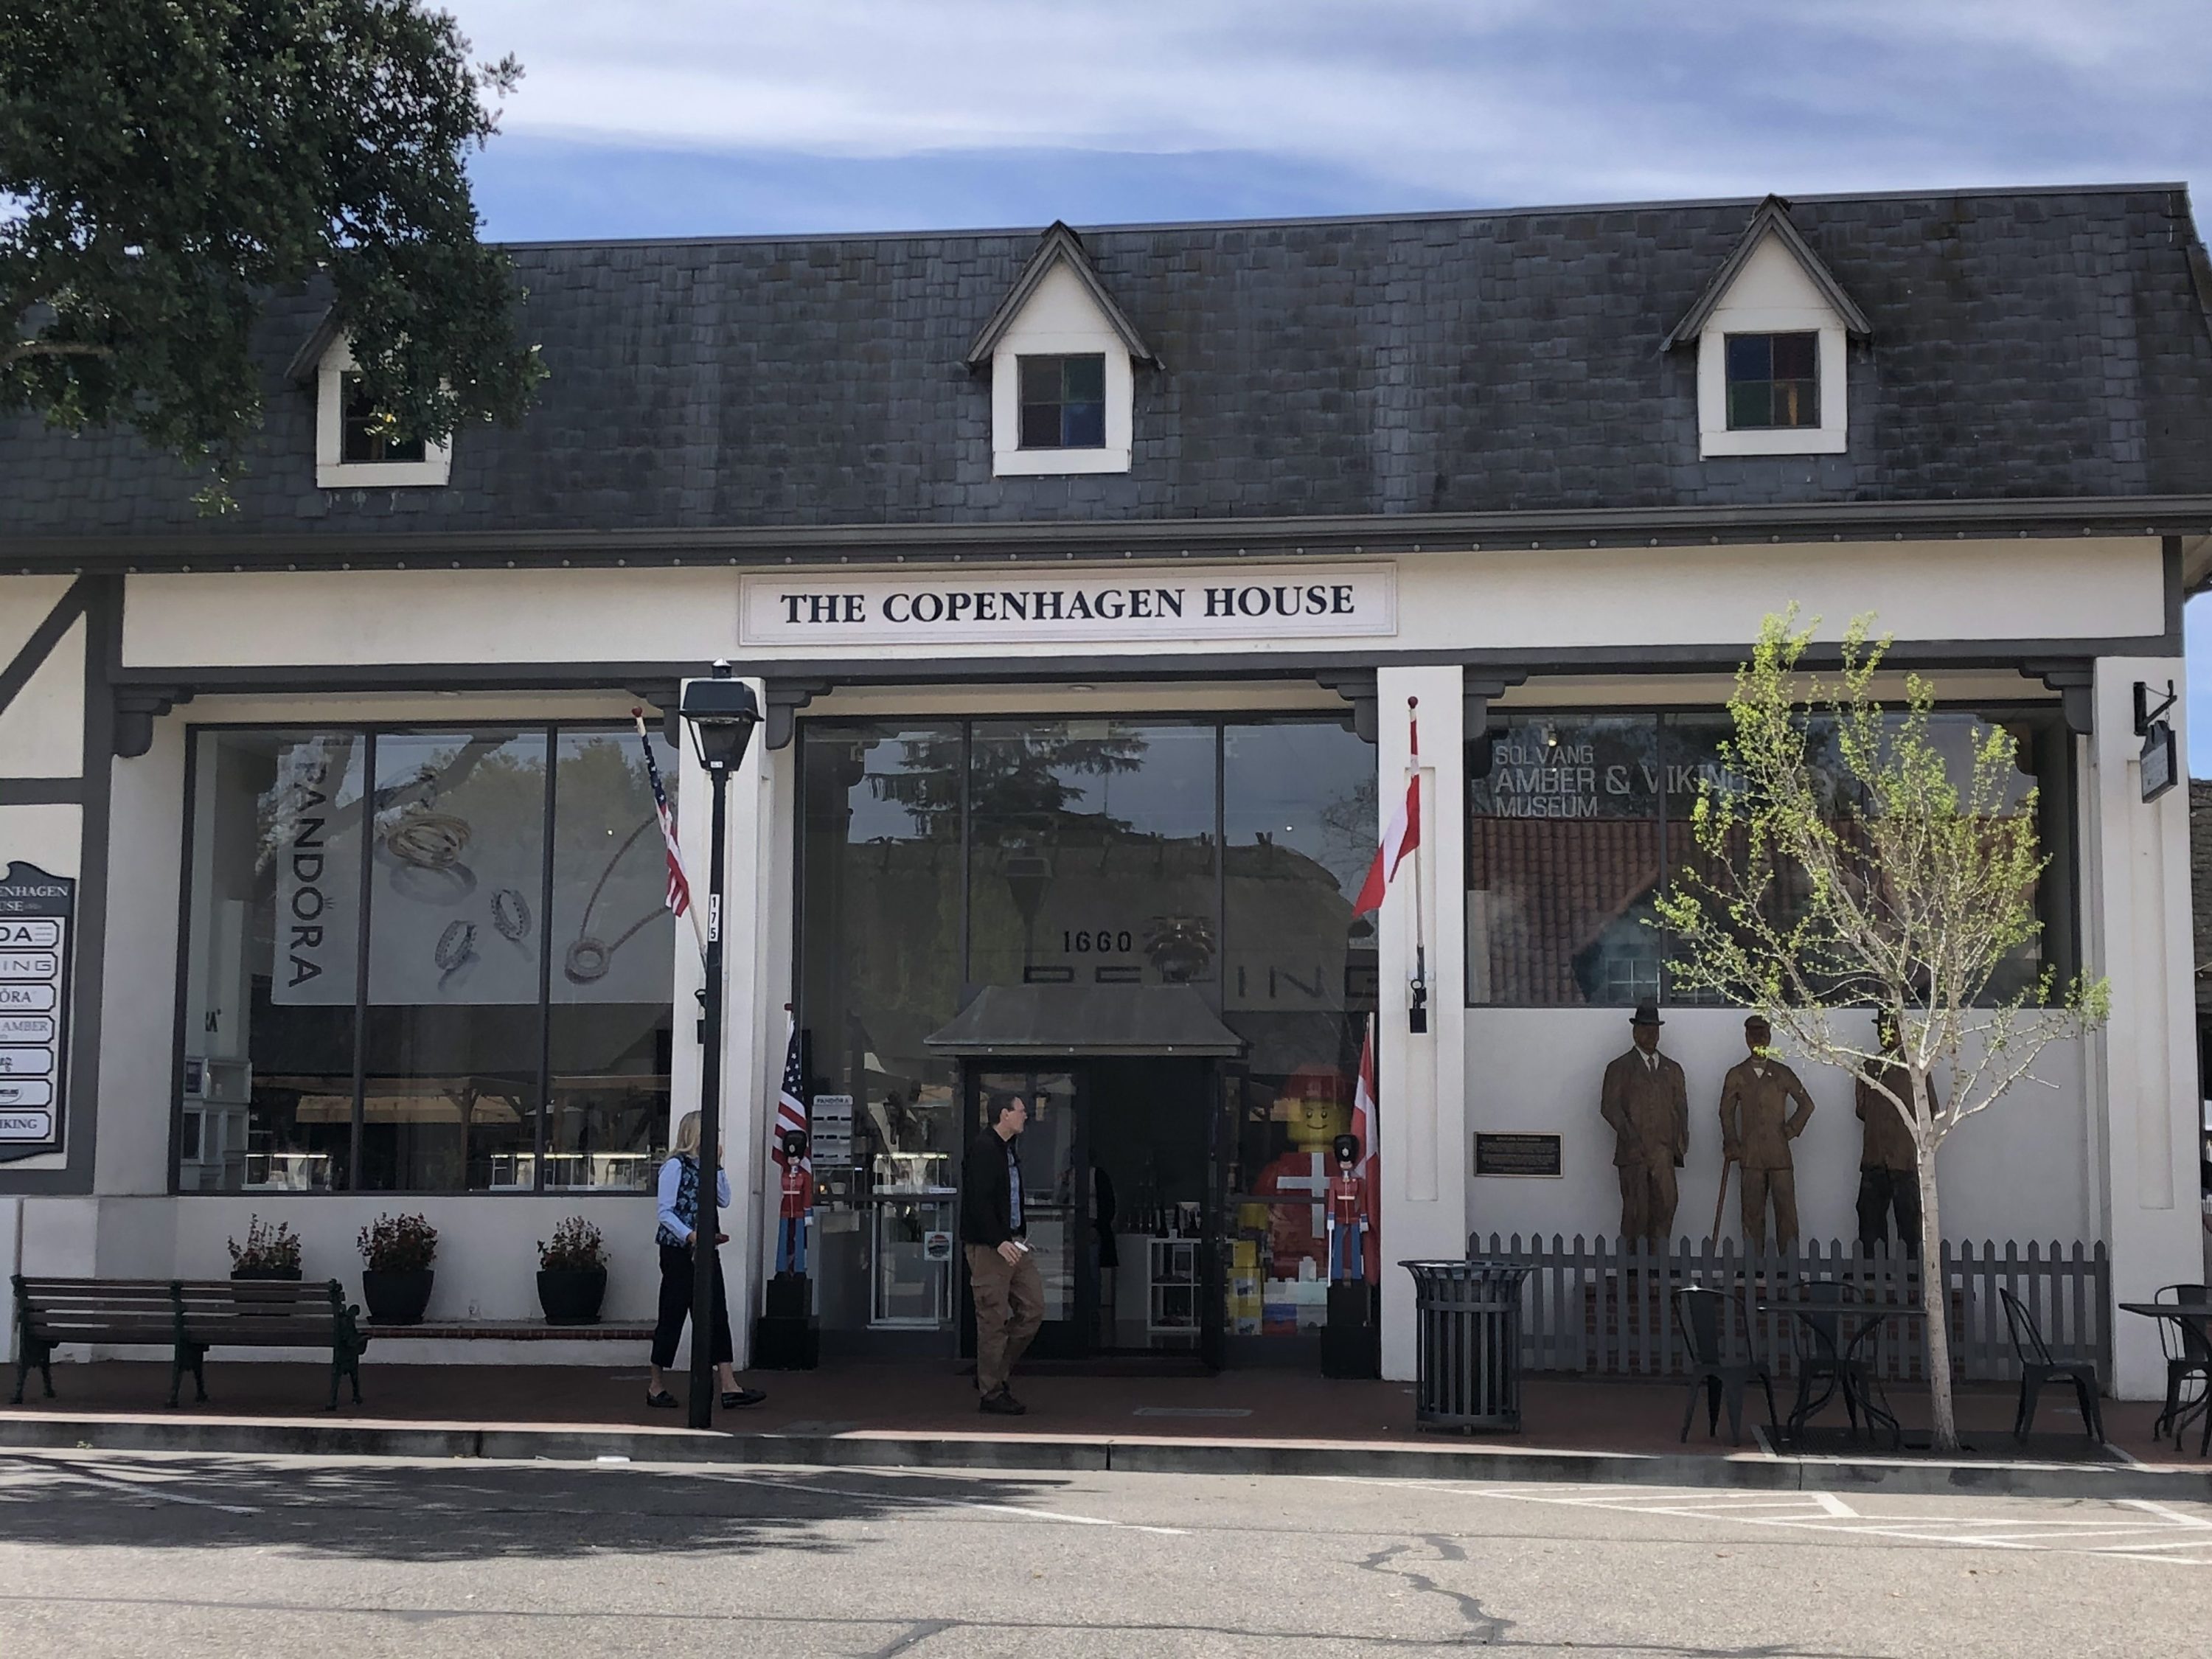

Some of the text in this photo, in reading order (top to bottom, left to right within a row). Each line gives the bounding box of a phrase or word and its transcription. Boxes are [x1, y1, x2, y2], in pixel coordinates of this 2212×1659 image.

[780, 585, 1355, 624] THE COPENHAGEN HOUSE
[1495, 745, 1594, 765] SOLVANG
[1495, 767, 1596, 794] AMBER
[1605, 765, 1631, 795] &
[1495, 796, 1599, 818] MUSEUM
[288, 762, 327, 988] PANDORA
[1064, 931, 1133, 953] 1660
[2, 1021, 49, 1032] AMBER
